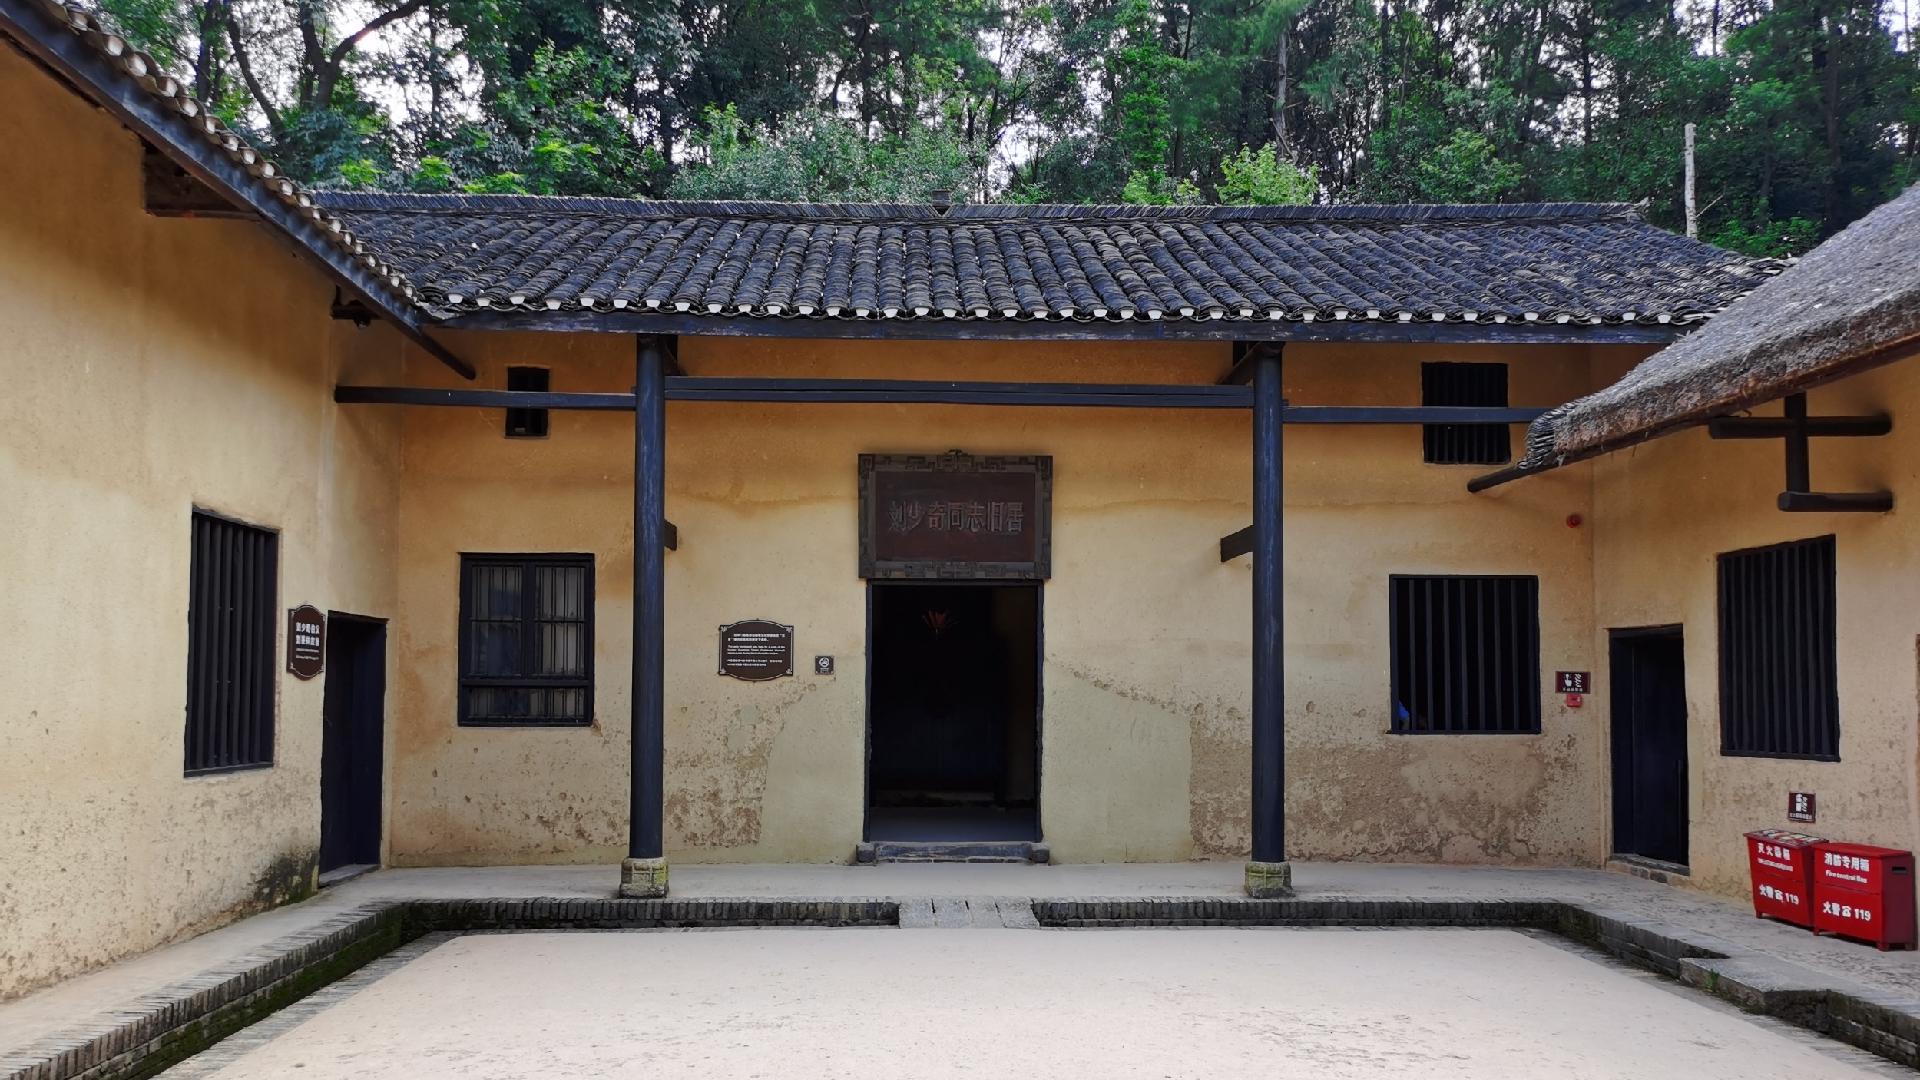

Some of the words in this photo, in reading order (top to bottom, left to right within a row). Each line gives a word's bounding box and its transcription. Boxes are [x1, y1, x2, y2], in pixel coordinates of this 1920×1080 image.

[888, 501, 1025, 533] 刘少奇同志旧居
[1785, 893, 1800, 905] 119
[1854, 908, 1872, 922] 119
